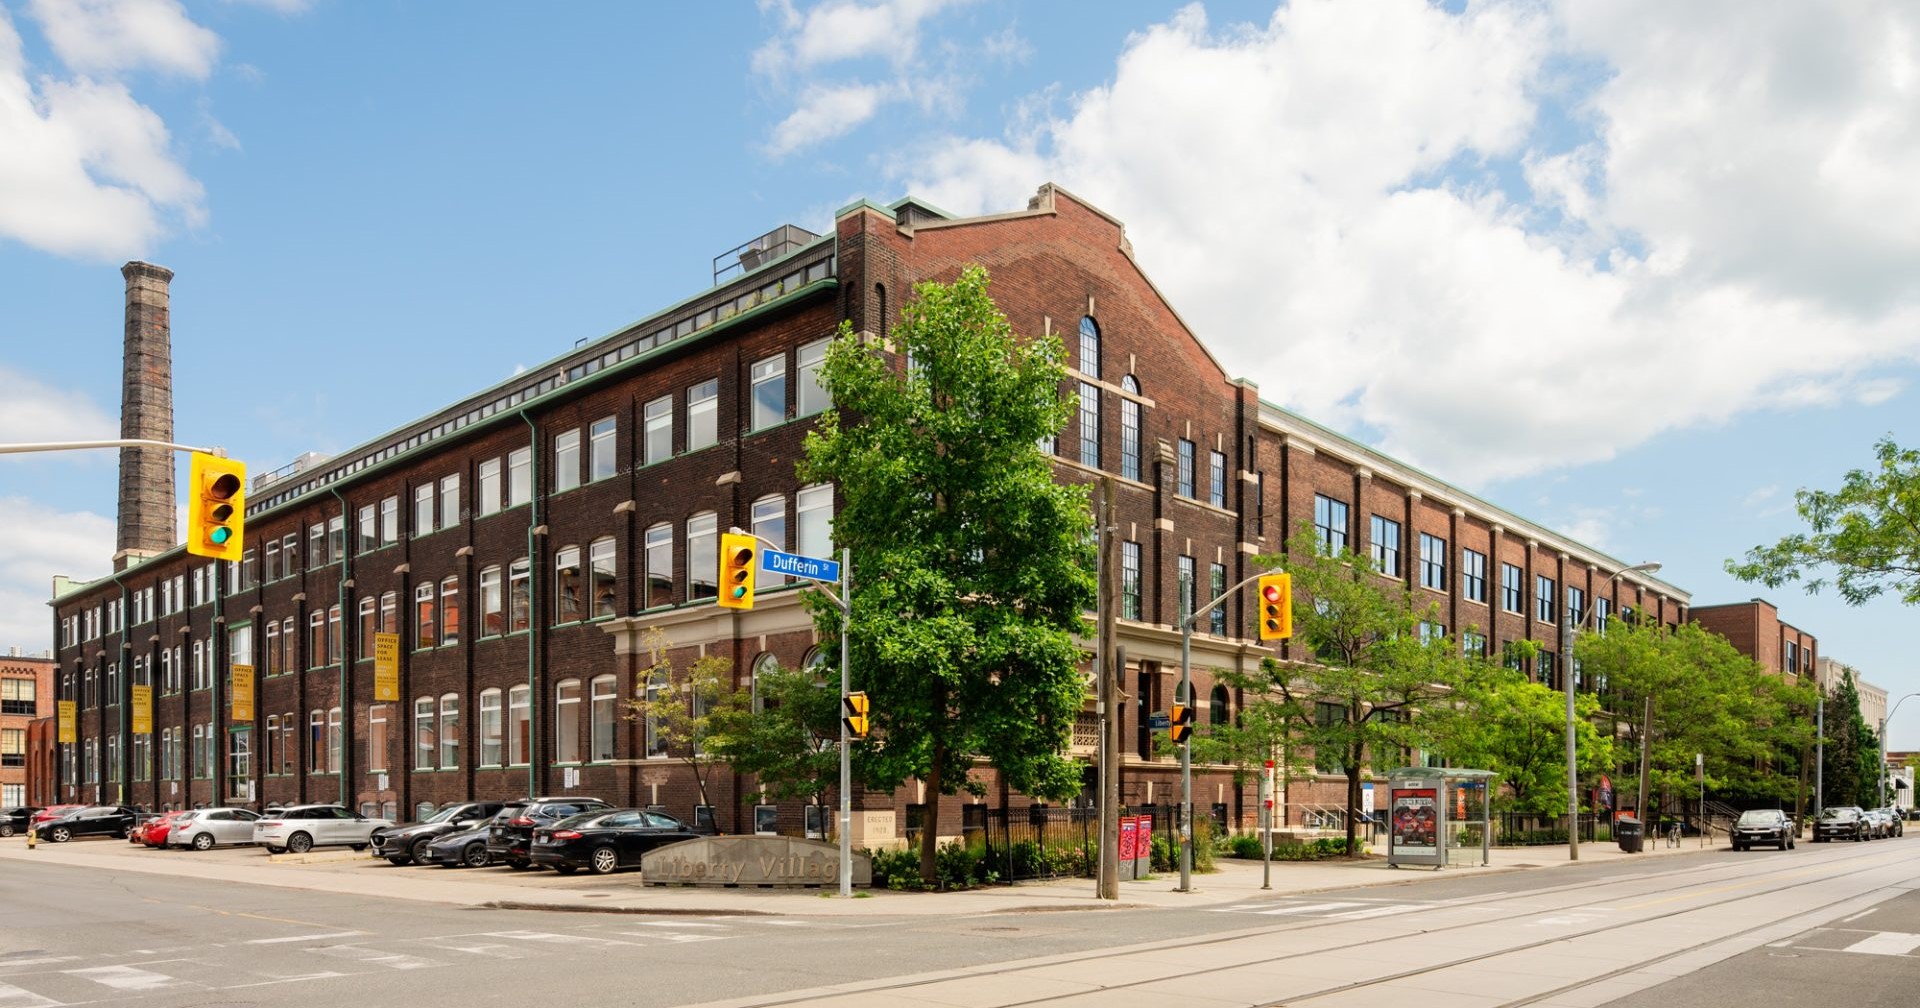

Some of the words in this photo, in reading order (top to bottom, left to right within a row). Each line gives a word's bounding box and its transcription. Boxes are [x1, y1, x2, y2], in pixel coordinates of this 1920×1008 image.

[773, 554, 818, 575] Dufferin
[867, 815, 893, 823] ERECTED
[657, 855, 746, 883] Liberty
[758, 855, 841, 883] Villag
